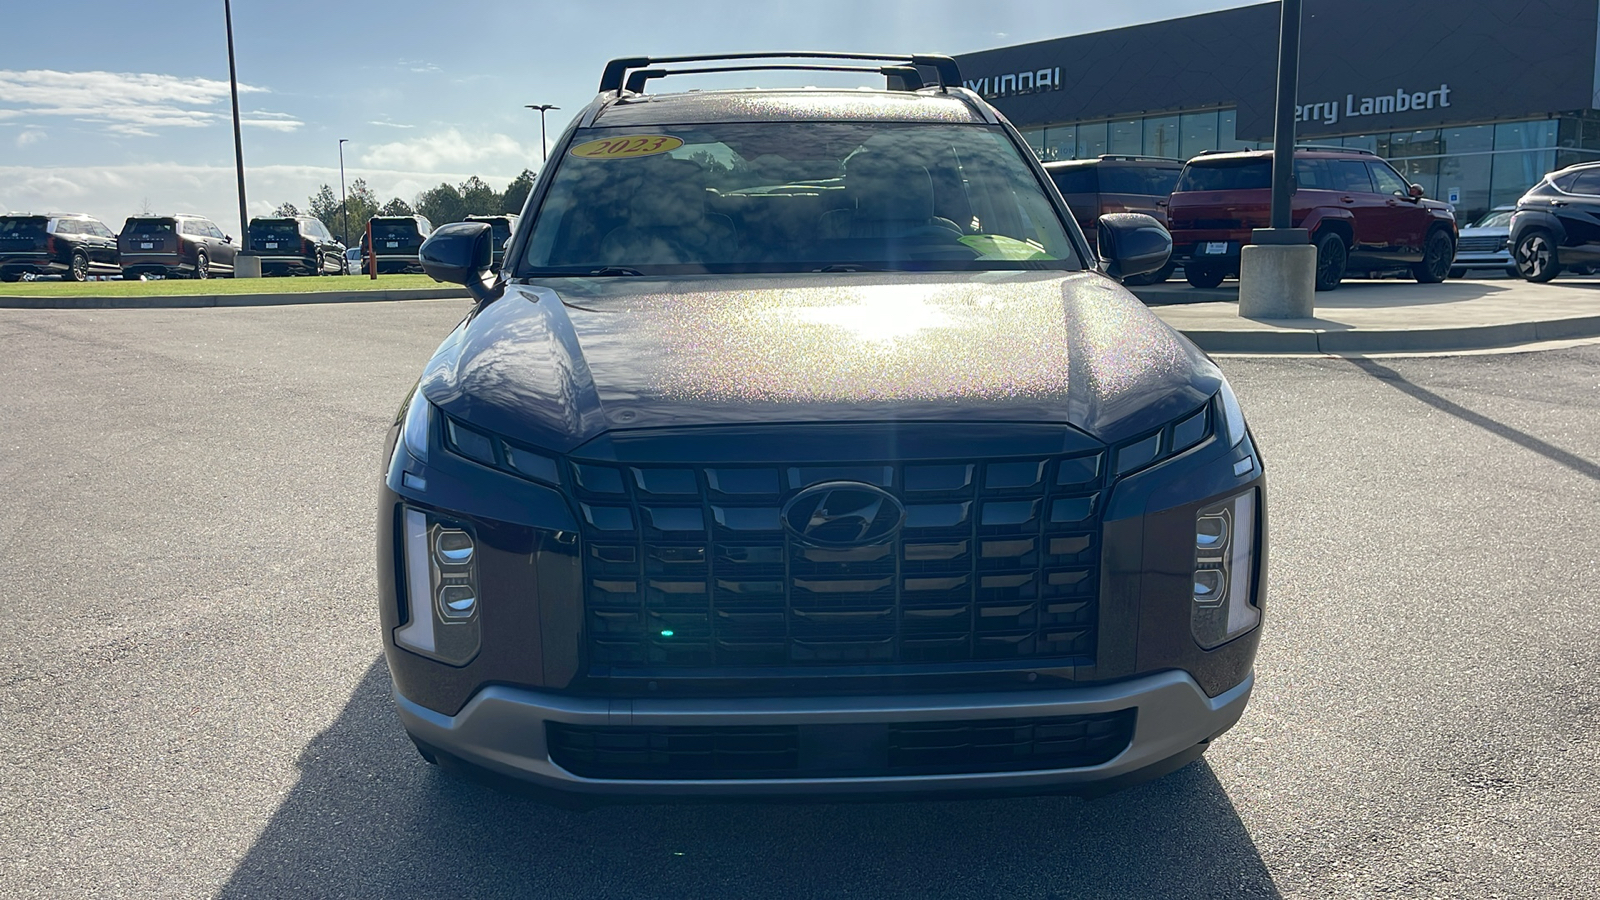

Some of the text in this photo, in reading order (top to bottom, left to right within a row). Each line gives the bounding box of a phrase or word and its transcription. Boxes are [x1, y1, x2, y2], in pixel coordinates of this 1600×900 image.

[963, 66, 1061, 99] YUNDAI
[1295, 84, 1451, 125] erry Lambert
[587, 137, 668, 156] 2023
